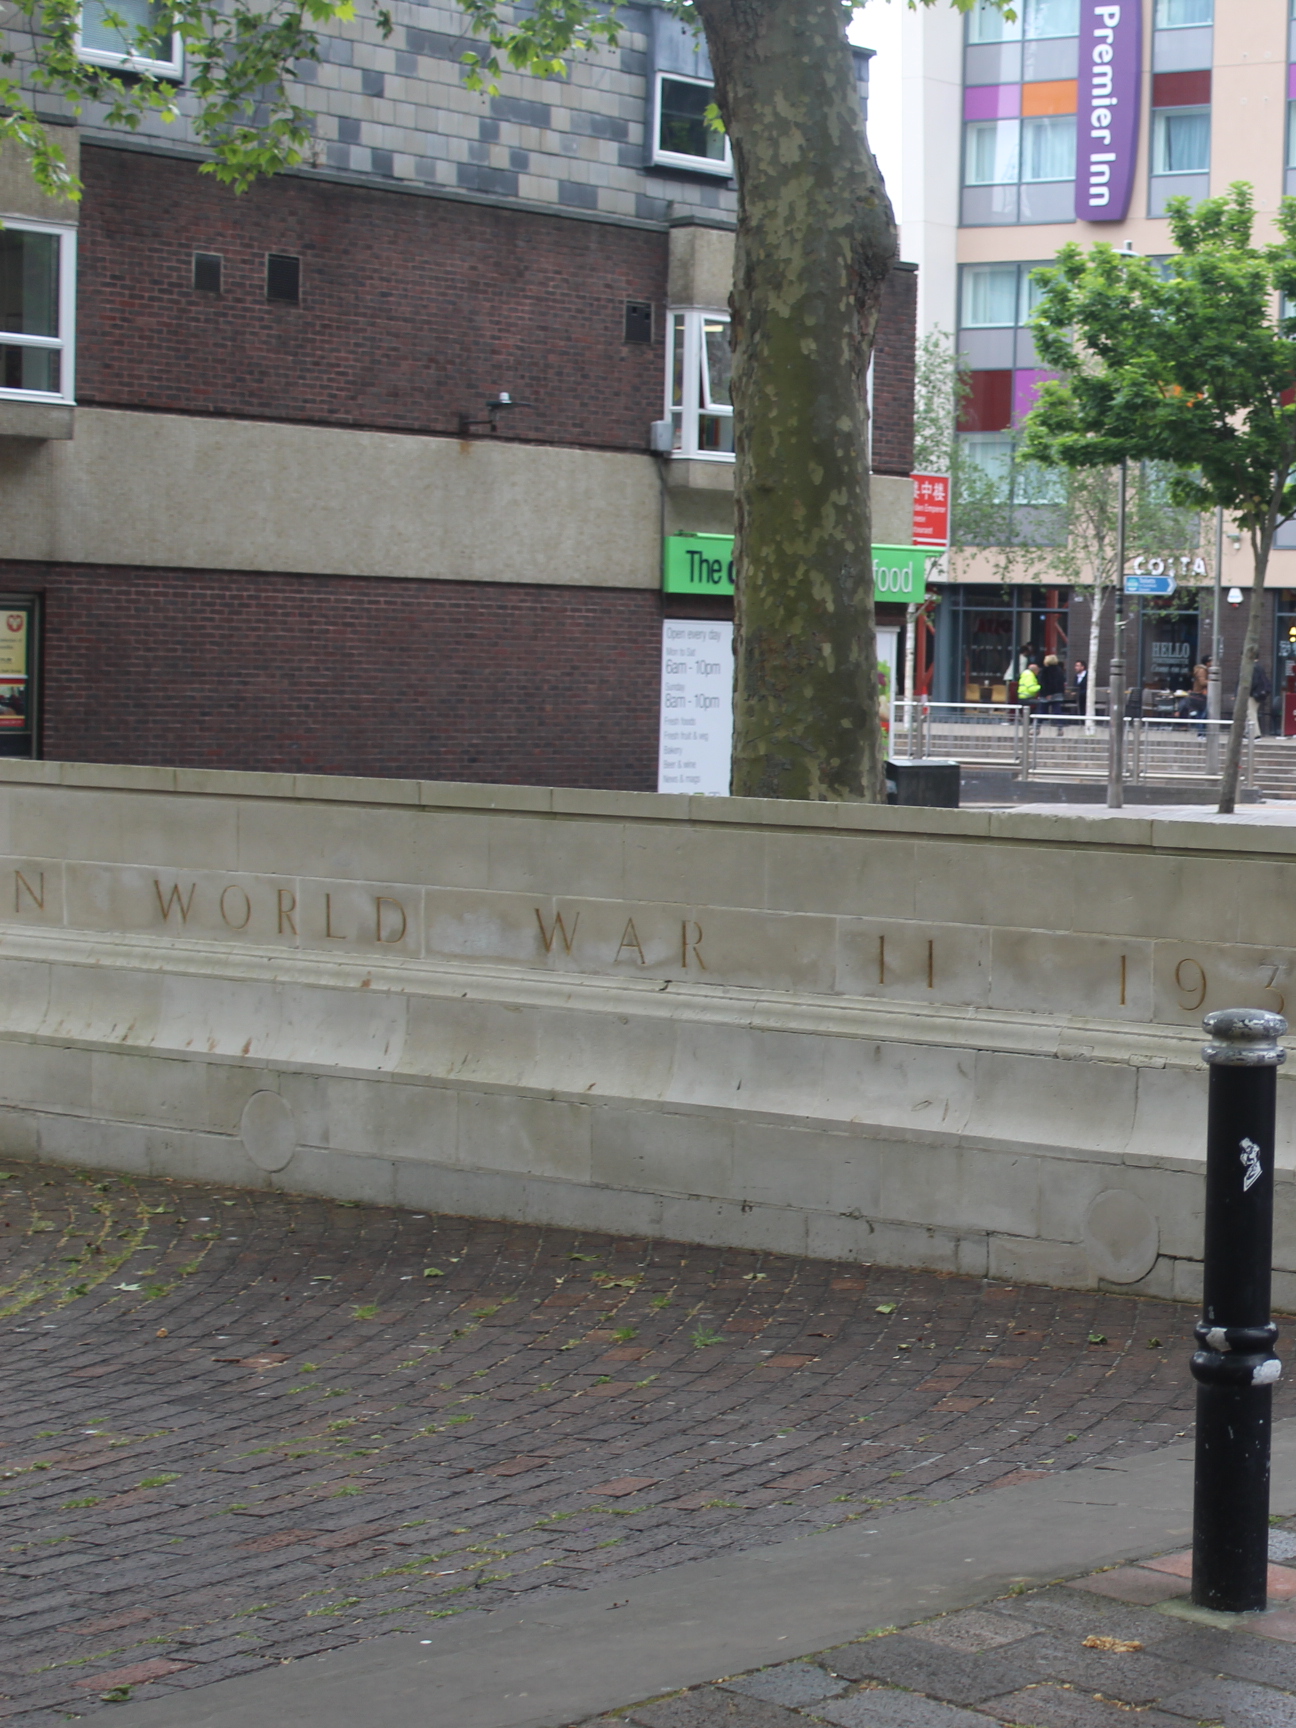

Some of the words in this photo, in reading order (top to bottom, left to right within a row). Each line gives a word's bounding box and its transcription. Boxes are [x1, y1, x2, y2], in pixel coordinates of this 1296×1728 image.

[1091, 5, 1121, 145] Premier
[1088, 152, 1117, 207] Inn
[685, 550, 722, 585] The
[872, 559, 913, 593] food
[1133, 556, 1208, 577] COSTA
[666, 627, 685, 640] Open
[687, 630, 706, 642] every
[708, 629, 721, 643] day
[666, 647, 678, 656] Mon
[686, 647, 696, 657] Sat
[1152, 642, 1190, 658] HELLO
[666, 659, 687, 674] 6am
[695, 660, 721, 677] 10pm
[665, 693, 686, 708] 8am
[694, 693, 720, 711] 10pm
[153, 877, 408, 945] WORLD
[533, 906, 707, 971] WAR
